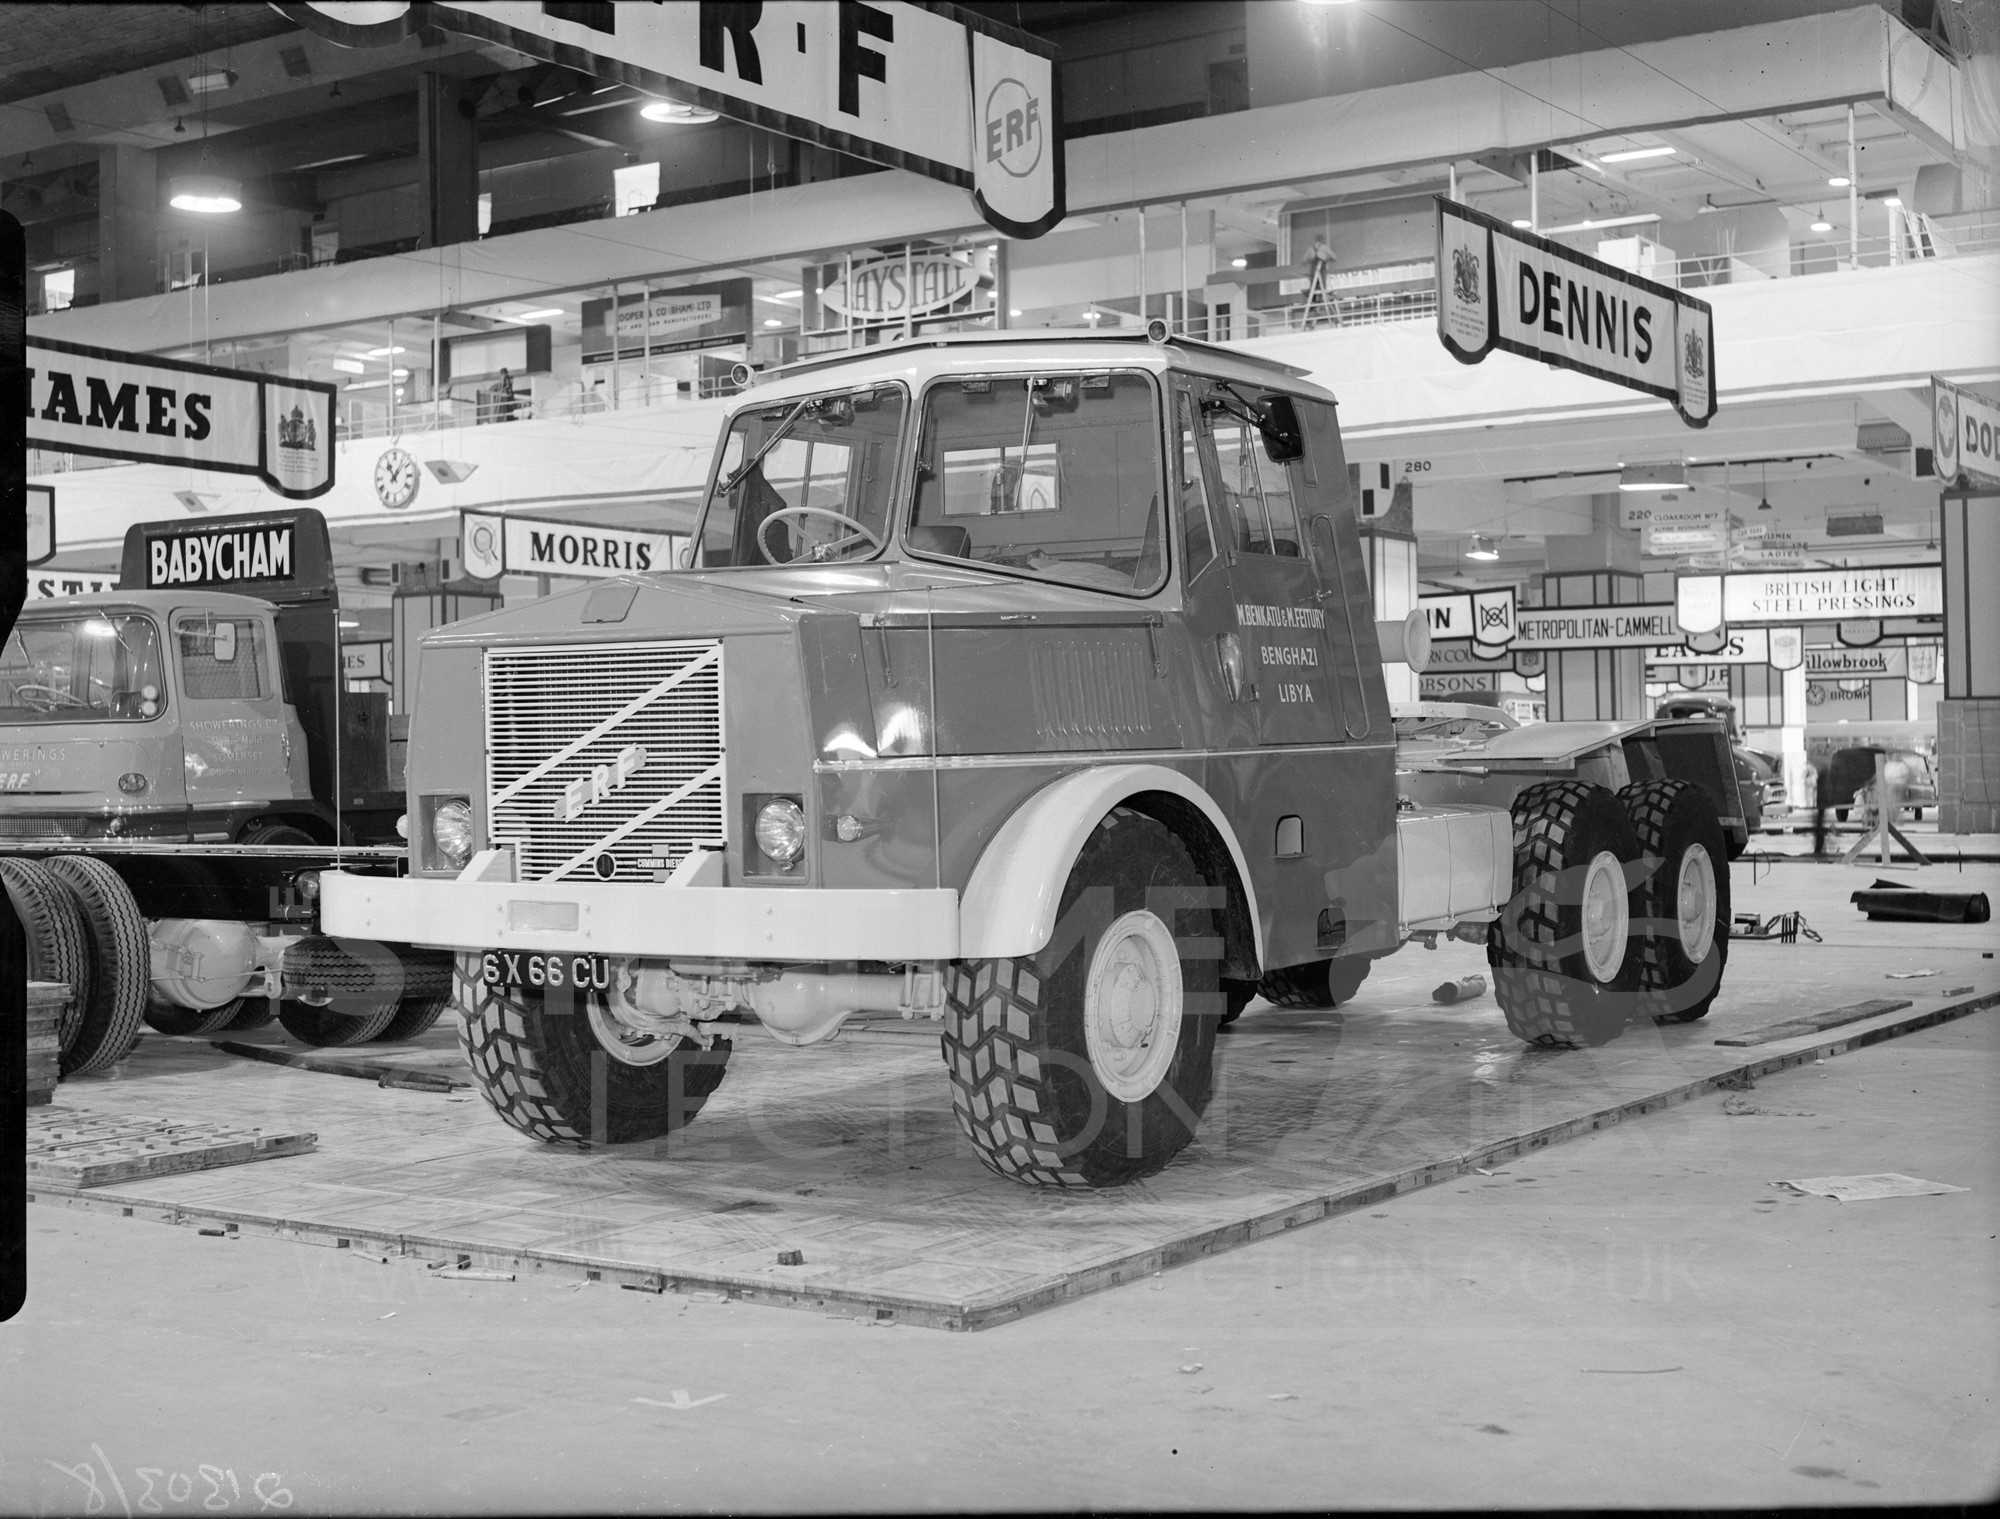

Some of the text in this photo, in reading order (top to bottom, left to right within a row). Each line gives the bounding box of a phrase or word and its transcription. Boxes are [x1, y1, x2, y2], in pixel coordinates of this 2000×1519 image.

[986, 98, 1039, 164] ERF
[614, 310, 644, 323] OOPER
[1519, 260, 1652, 364] DENNIS
[26, 368, 211, 441] AMES
[1404, 461, 1432, 473] 280
[1628, 510, 1652, 521] 220
[151, 529, 291, 586] BABYCHAM
[530, 531, 652, 571] MORRIS
[1763, 576, 1900, 597] BRITISH LIGHT
[1752, 593, 1916, 614] STEEL PRESSINGS
[1518, 616, 1676, 642] METROPOLITAN-CAMMELL
[1260, 646, 1319, 666] BENGHAZI
[1804, 650, 1887, 672] illowbrook
[1278, 683, 1314, 703] LIBYA
[563, 743, 646, 823] ERF
